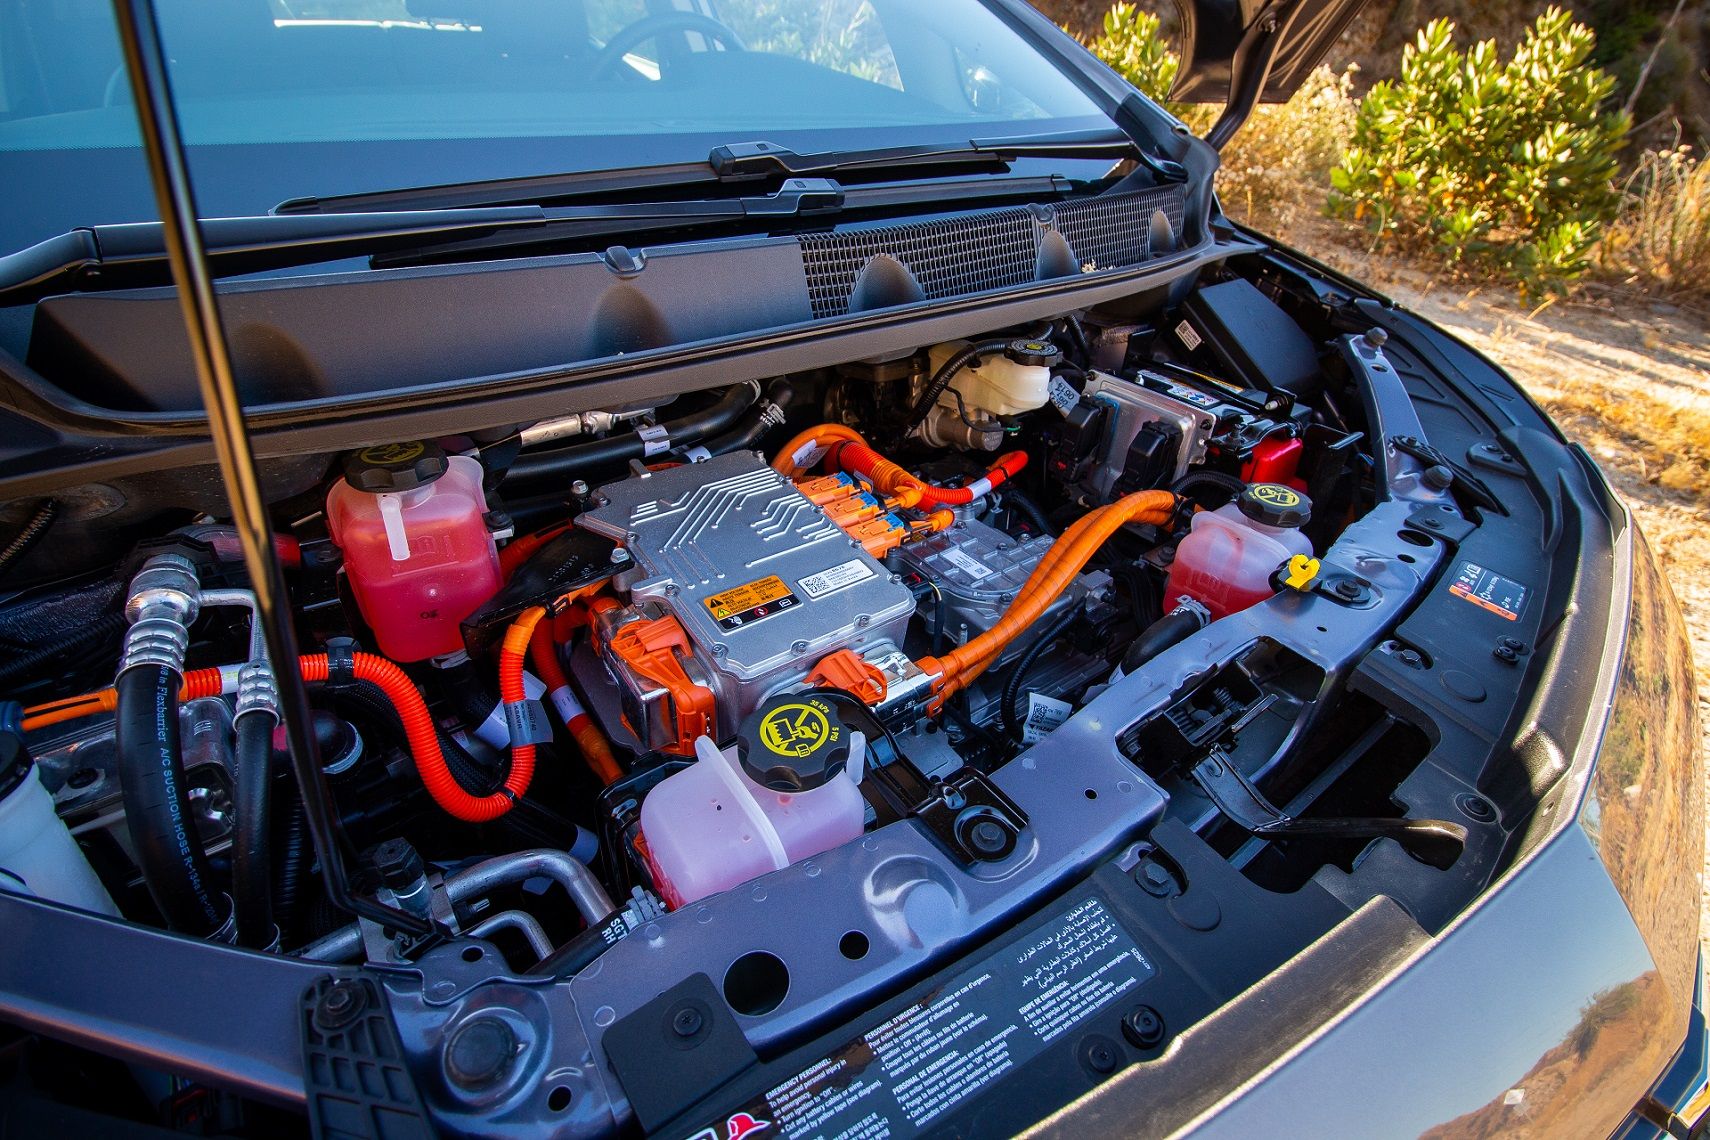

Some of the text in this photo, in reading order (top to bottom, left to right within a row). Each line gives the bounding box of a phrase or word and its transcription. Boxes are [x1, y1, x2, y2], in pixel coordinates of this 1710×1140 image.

[157, 685, 167, 742] Flexbarrier
[818, 702, 829, 713] kPa
[829, 730, 839, 741] PSI
[160, 747, 171, 766] A/C
[163, 769, 179, 821] SUCTION
[173, 823, 190, 855] HOSE
[601, 926, 616, 943] RH
[610, 917, 627, 939] SGT
[864, 1021, 893, 1040] PERSONNEL
[892, 1005, 920, 1024] D'URGENCE
[766, 1058, 831, 1099] EMERGENCY PERSONNEL:
[892, 1050, 959, 1095] PERSONAL DE EMERGENCIA:
[897, 1093, 910, 1103] Para
[909, 1084, 923, 1096] evitar
[922, 1071, 943, 1087] lesiones
[943, 1056, 968, 1075] personales
[974, 1044, 985, 1054] caso
[991, 1025, 1018, 1043] emergencia,
[776, 1094, 789, 1104] help
[789, 1084, 804, 1097] avoid
[804, 1071, 826, 1089] personal
[826, 1063, 840, 1074] injury
[781, 1092, 811, 1112] emergency.
[781, 1112, 794, 1122] Turn
[794, 1100, 814, 1115] ignition
[820, 1087, 836, 1097] "Off".
[785, 1121, 796, 1131] Cut
[796, 1116, 806, 1125] any
[805, 1104, 825, 1119] battery
[825, 1094, 842, 1107] cables
[848, 1080, 863, 1092] wires
[789, 1123, 810, 1140] marked
[817, 1109, 834, 1124] yellow
[834, 1102, 847, 1112] tape
[846, 1094, 858, 1105] (see
[858, 1080, 882, 1097] diagram).
